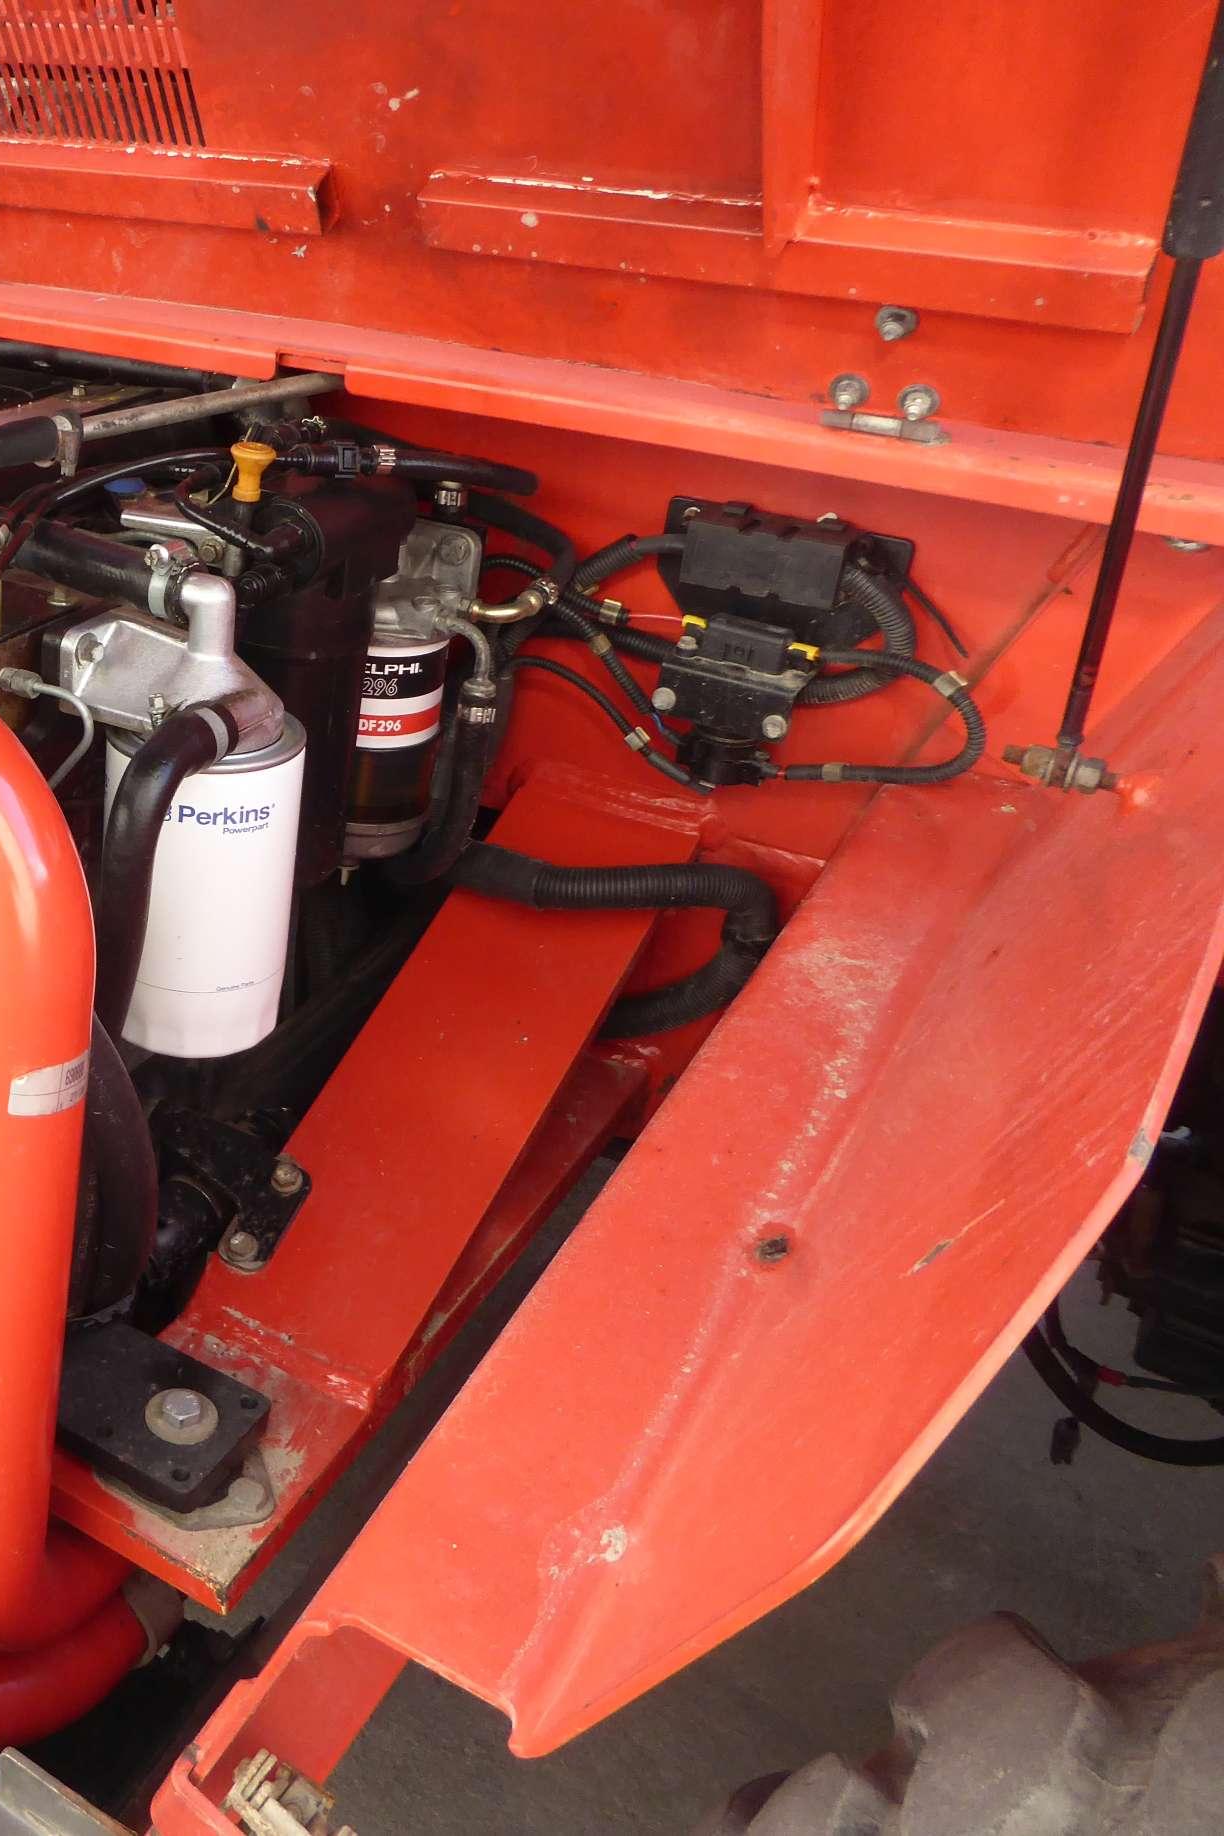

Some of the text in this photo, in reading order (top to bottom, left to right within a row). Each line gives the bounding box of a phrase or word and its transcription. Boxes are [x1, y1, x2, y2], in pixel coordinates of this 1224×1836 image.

[362, 677, 398, 696] 296
[358, 719, 402, 732] DF296
[178, 804, 271, 826] Perkins
[222, 822, 270, 835] Powerpart
